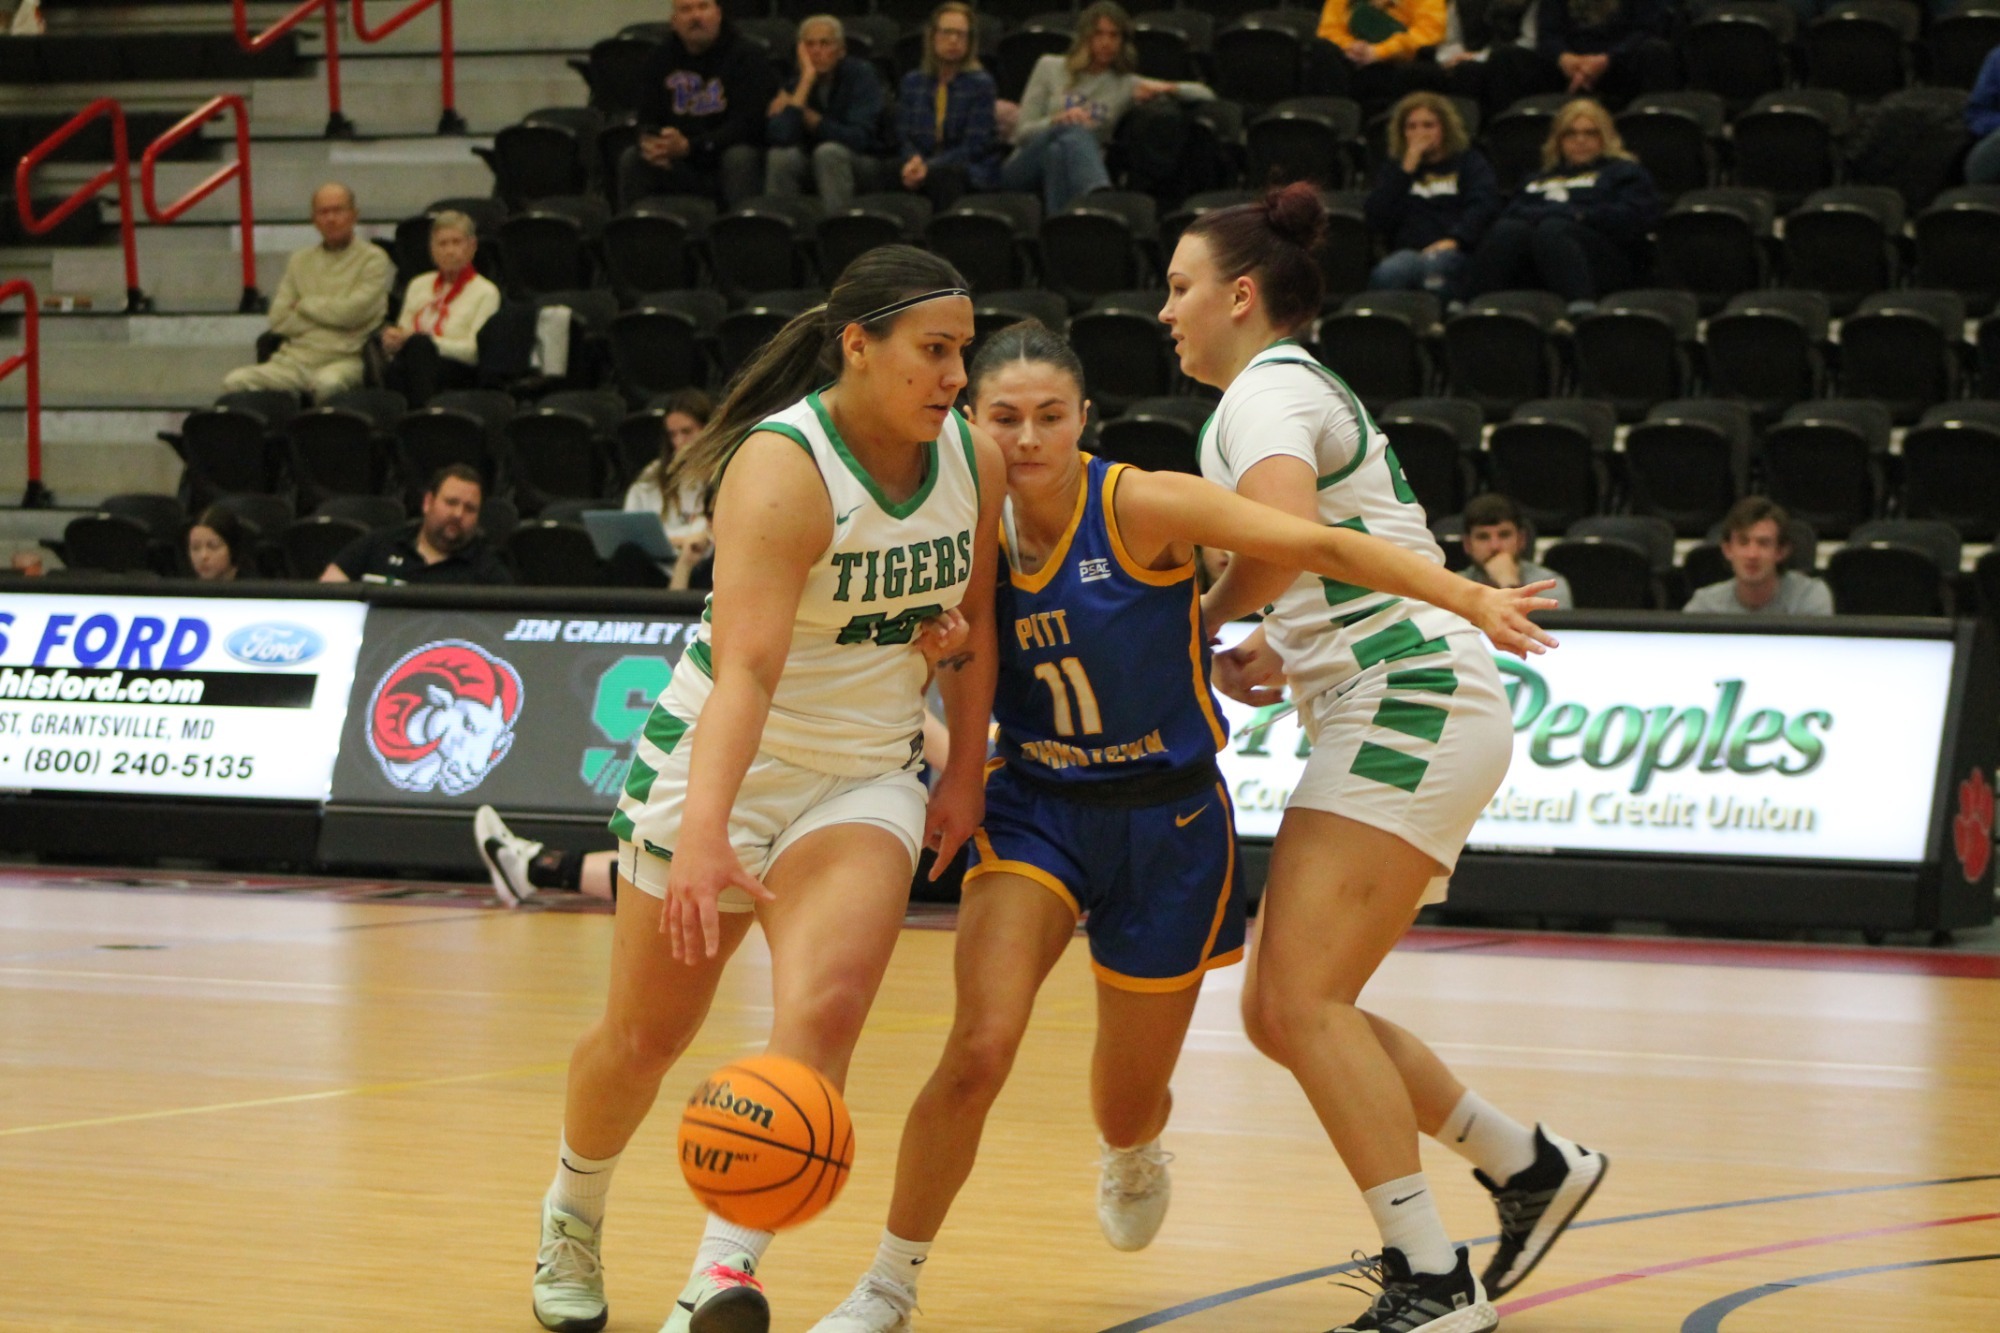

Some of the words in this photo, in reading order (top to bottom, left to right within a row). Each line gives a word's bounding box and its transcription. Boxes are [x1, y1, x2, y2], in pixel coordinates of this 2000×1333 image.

[832, 530, 971, 602] TIGERS
[1080, 563, 1111, 577] PSAC
[32, 613, 211, 670] FORD
[241, 626, 308, 661] Ford
[504, 619, 561, 641] JIM
[562, 620, 683, 645] CRAWLEY
[1015, 609, 1071, 651] PITT
[1034, 657, 1103, 736] 11
[31, 712, 172, 741] GRANTSVILLE,
[181, 718, 214, 740] MD
[24, 748, 101, 775] (800)
[111, 751, 255, 780] 240-5135
[1478, 786, 1577, 823] deral
[1587, 791, 1693, 829] Credit
[1703, 795, 1815, 832] Union
